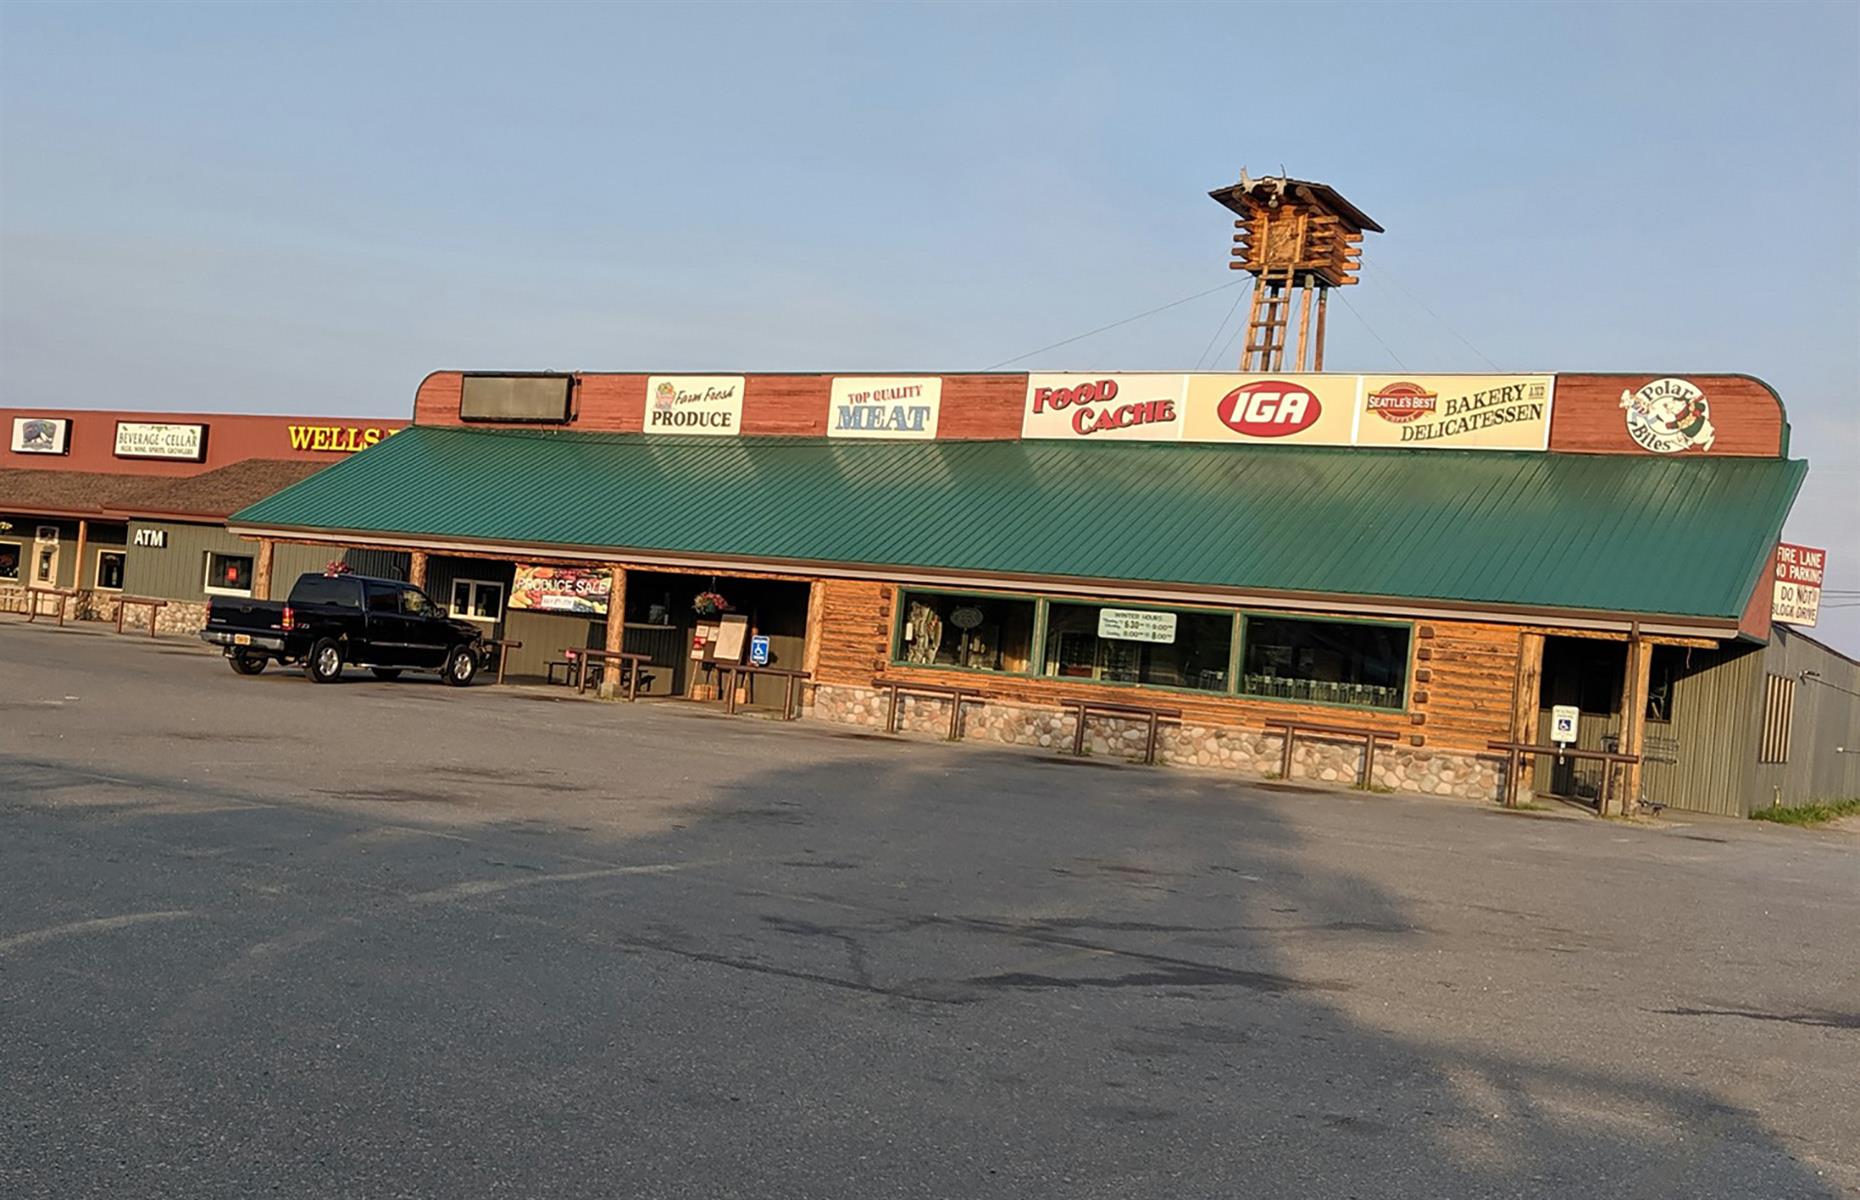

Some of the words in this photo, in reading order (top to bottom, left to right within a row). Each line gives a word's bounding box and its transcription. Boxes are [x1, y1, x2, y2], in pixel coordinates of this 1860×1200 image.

[674, 388, 702, 405] Farm
[703, 385, 736, 403] Fresh
[847, 391, 872, 405] TOP
[873, 384, 923, 402] QUALITY
[1032, 379, 1118, 413] FOOD
[1444, 383, 1528, 417] BAKERY
[1641, 380, 1694, 401] Polar
[1229, 391, 1311, 424] IGA
[1369, 395, 1412, 409] SEATTLE'S
[1412, 396, 1436, 409] BEST
[651, 410, 732, 428] PRODUCE
[835, 405, 931, 432] MEAT
[1072, 399, 1177, 435] CACHE
[1400, 403, 1544, 442] DELICATESSEN
[119, 432, 160, 446] BEVERAGE
[165, 434, 198, 447] CELLAR
[288, 425, 381, 452] WELLS
[133, 528, 164, 547] ATM
[1777, 546, 1798, 564] FIRE
[1799, 550, 1823, 569] LANE
[1789, 564, 1823, 584] PARKING
[515, 577, 573, 593] PRODUCE
[575, 579, 606, 595] SALE
[1780, 586, 1794, 602] DO
